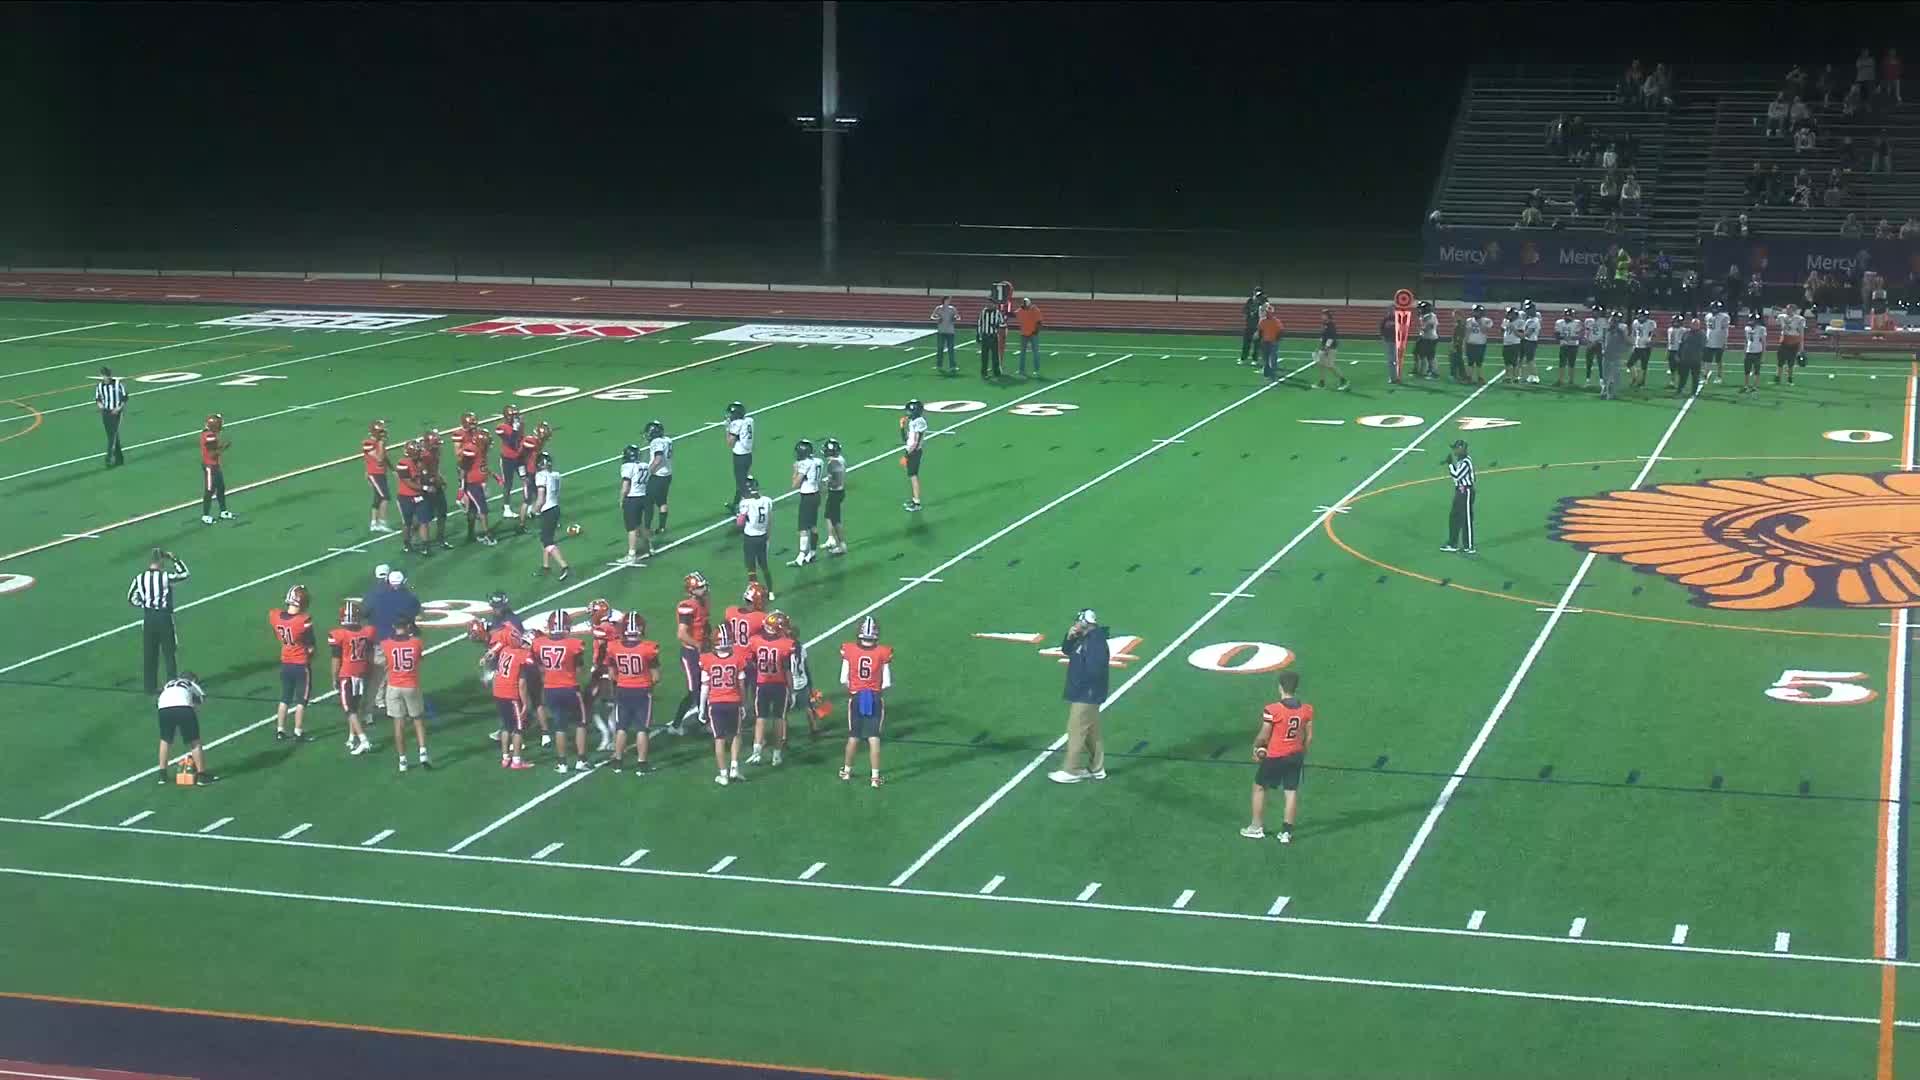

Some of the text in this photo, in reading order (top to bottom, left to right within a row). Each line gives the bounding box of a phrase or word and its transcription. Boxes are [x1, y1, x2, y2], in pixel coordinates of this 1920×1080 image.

[1439, 247, 1488, 264] Mercy
[1807, 254, 1858, 272] Mercy
[757, 506, 766, 524] 6
[277, 624, 297, 647] 31
[730, 617, 750, 647] 18
[350, 637, 369, 661] 17
[392, 647, 415, 672] 15
[540, 646, 566, 670] 57
[756, 648, 778, 674] 21
[616, 653, 643, 676] 50
[711, 665, 738, 688] 23
[857, 655, 872, 681] 6
[1764, 670, 1879, 706] 5
[1285, 715, 1302, 741] 2
